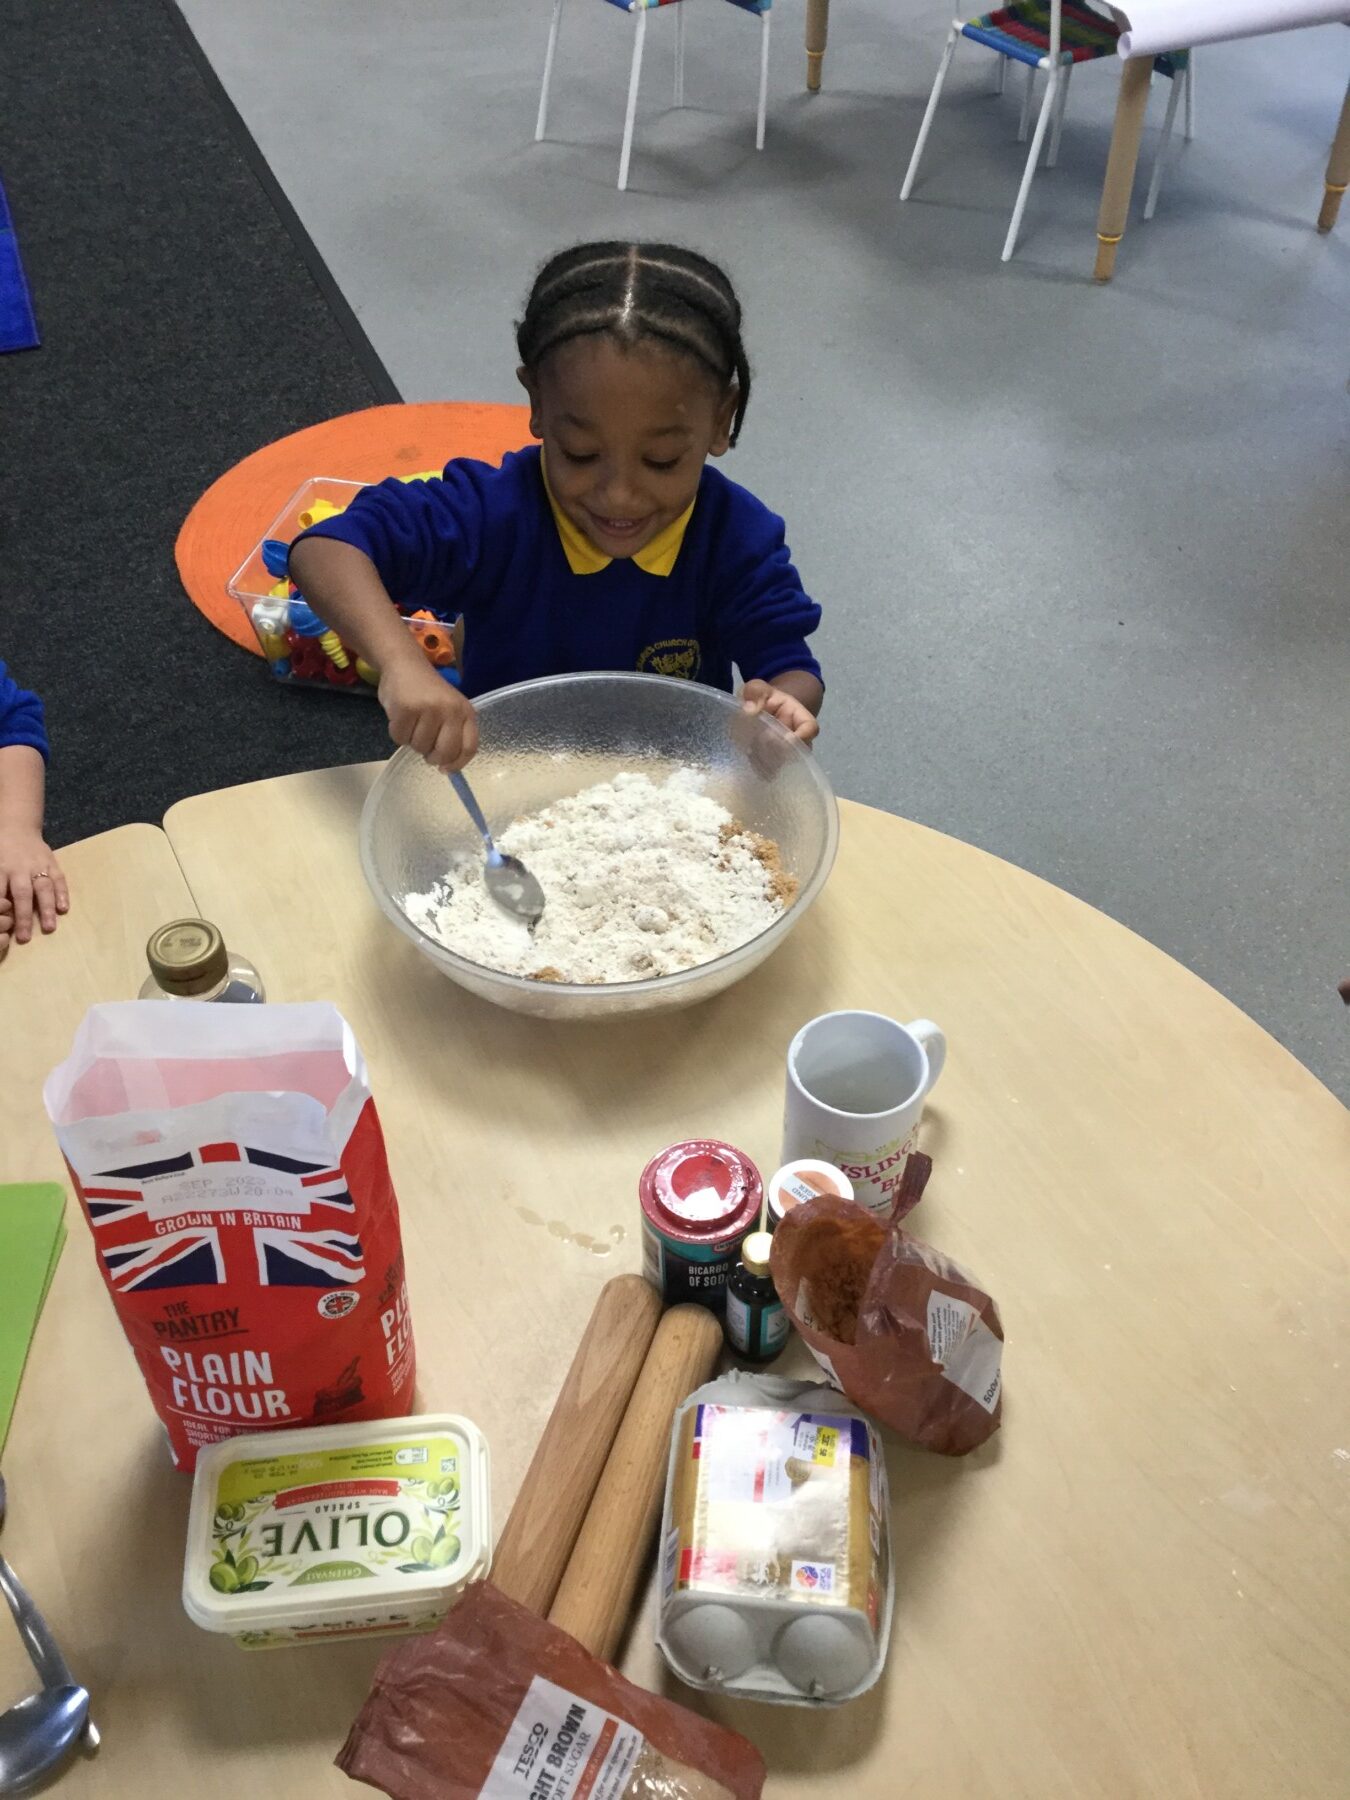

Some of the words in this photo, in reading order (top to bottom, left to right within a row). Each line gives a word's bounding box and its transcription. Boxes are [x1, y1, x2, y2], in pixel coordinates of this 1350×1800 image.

[178, 1178, 213, 1190] SEP
[154, 1212, 214, 1236] GROWN
[219, 1213, 237, 1227] IN
[243, 1212, 302, 1231] BRITAIN
[688, 1262, 729, 1276] BICARBO
[688, 1276, 701, 1288] OF
[152, 1306, 241, 1340] PANTRY
[163, 1300, 192, 1317] THE
[160, 1345, 274, 1386] PLAIN
[172, 1377, 292, 1419] FLOUR
[183, 1420, 208, 1433] IDEAL
[213, 1425, 231, 1435] FOR
[314, 1500, 361, 1514] SPREAD
[261, 1510, 411, 1558] OLIVE
[513, 1722, 545, 1775] TESCO
[546, 1703, 587, 1769] BROWN
[564, 1732, 592, 1776] SUGAR
